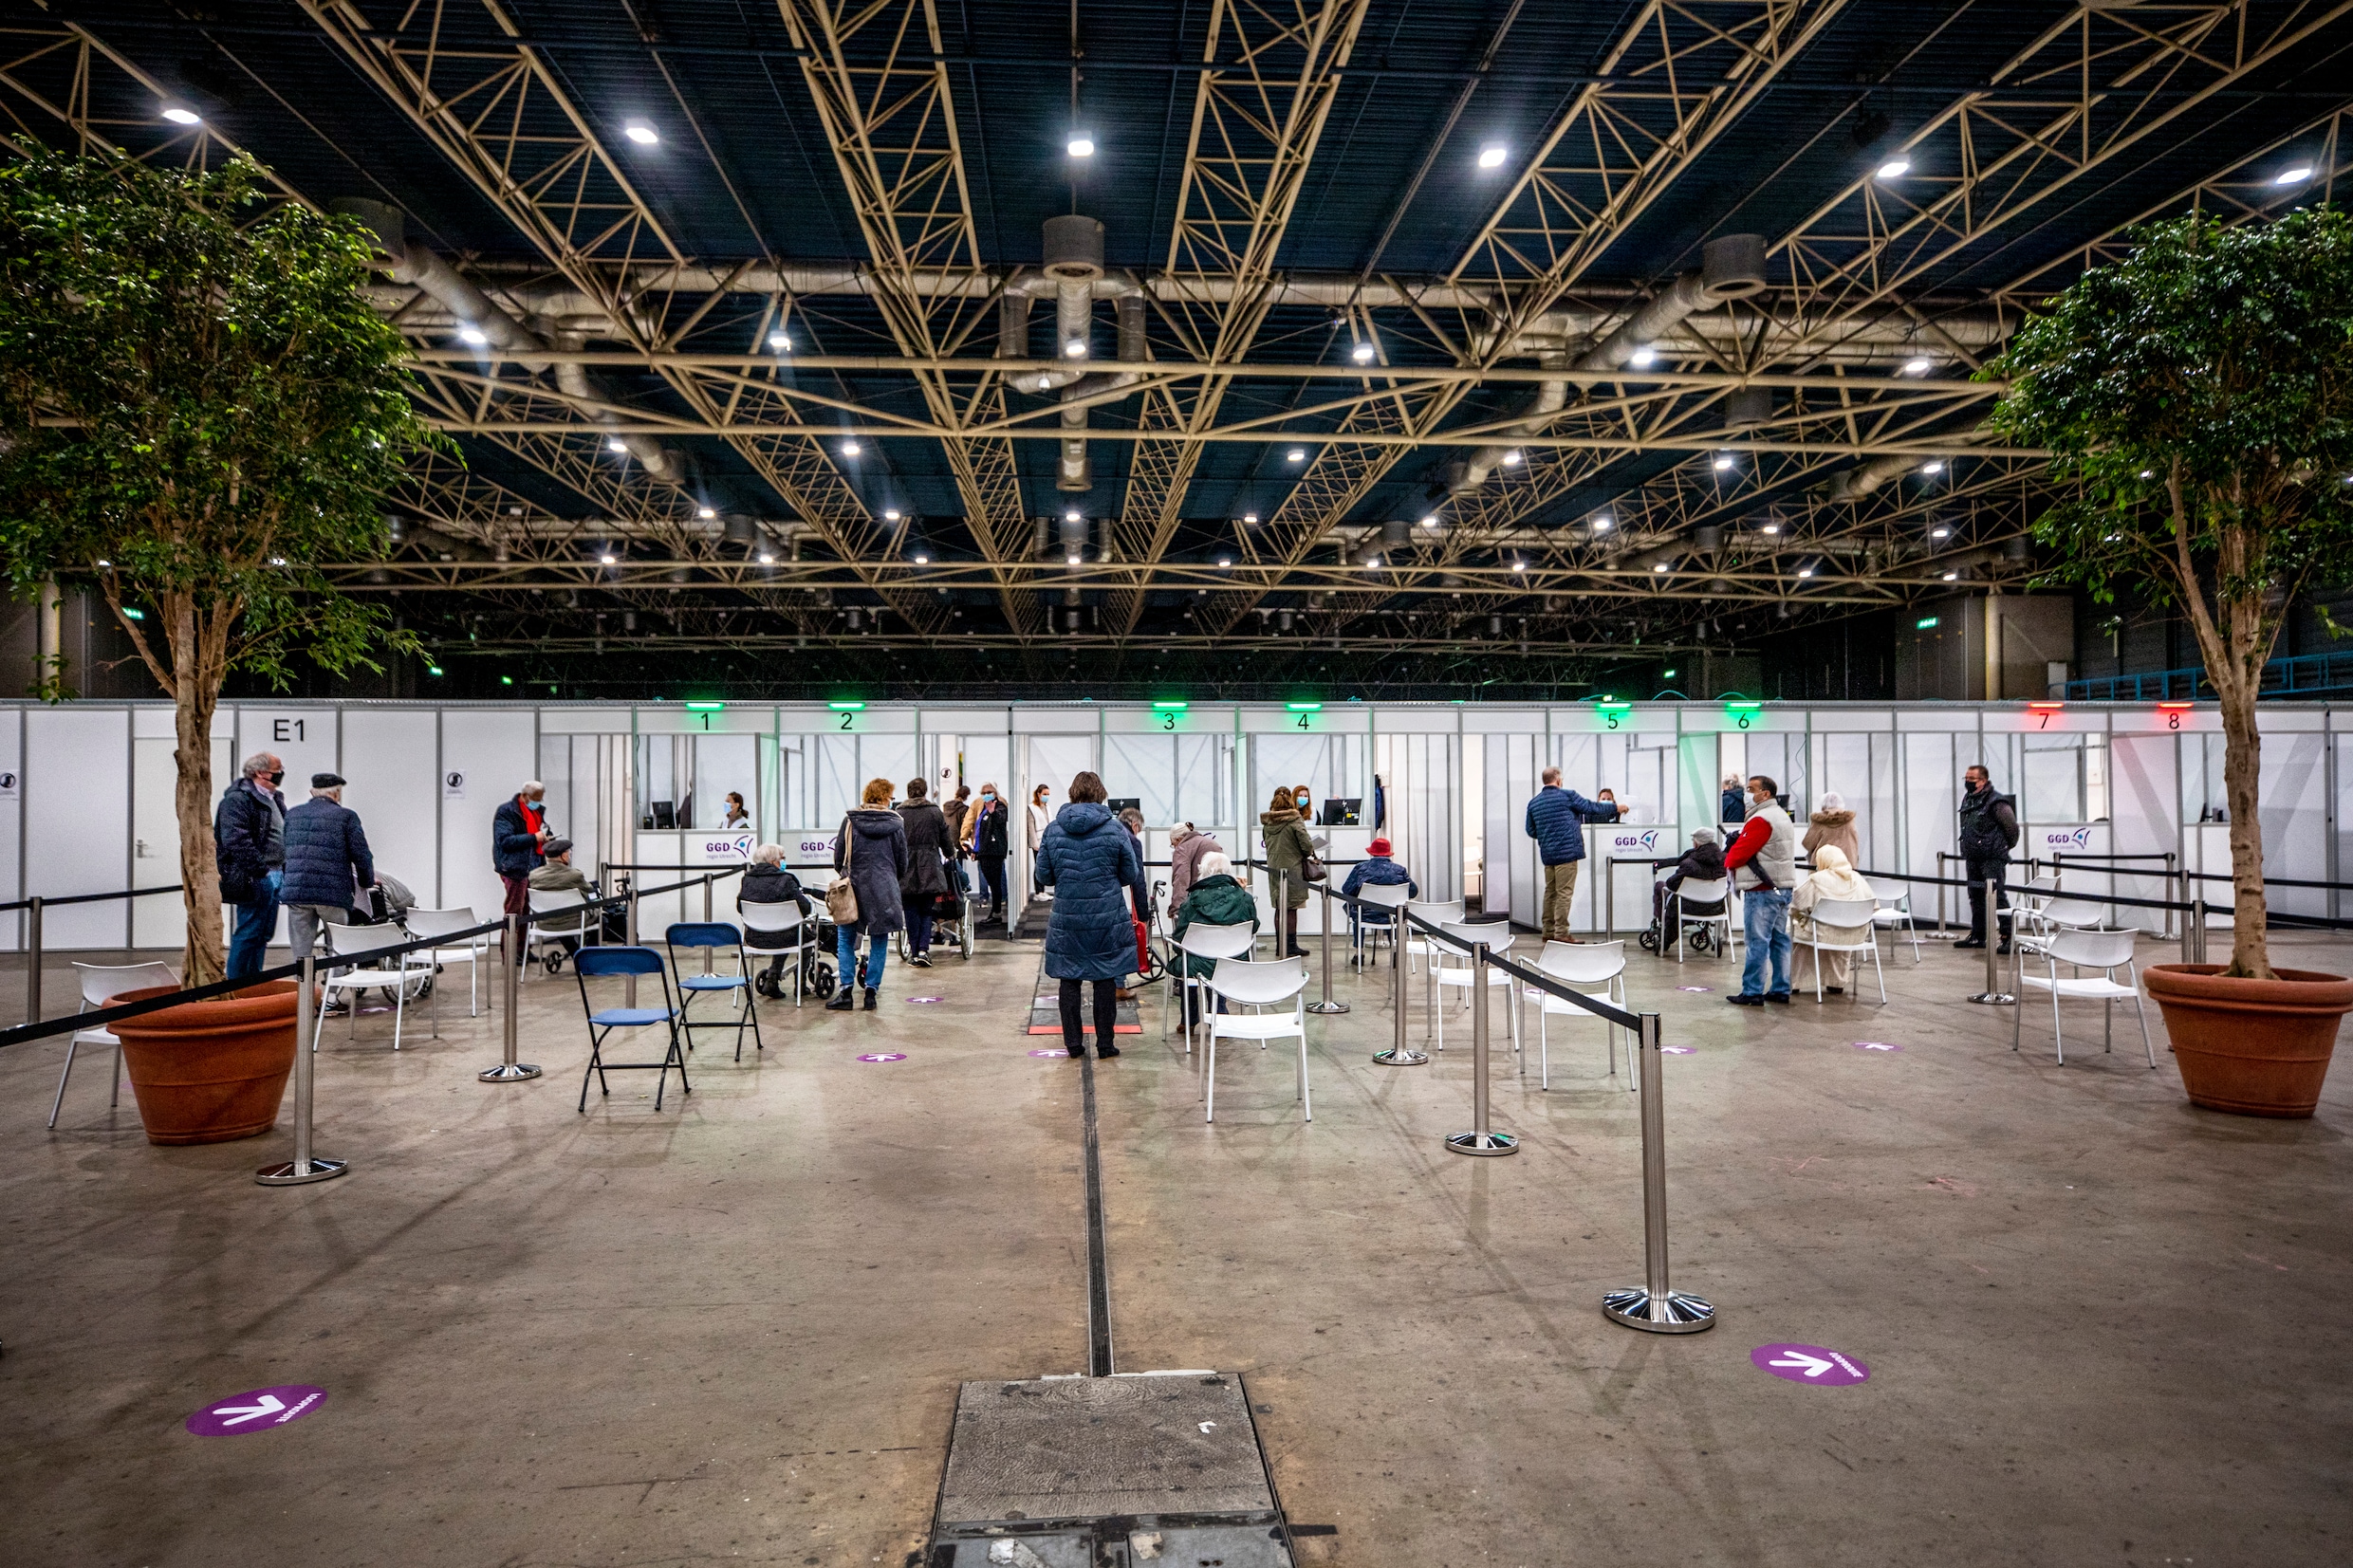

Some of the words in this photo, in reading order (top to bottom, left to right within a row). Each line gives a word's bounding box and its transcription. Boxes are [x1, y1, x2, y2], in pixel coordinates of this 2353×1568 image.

[701, 712, 709, 730] 1
[841, 712, 853, 730] 2
[1163, 712, 1176, 730] 3
[1297, 712, 1309, 730] 4
[1607, 713, 1619, 729] 5
[1738, 712, 1750, 729] 6
[2039, 712, 2049, 729] 7
[2169, 712, 2180, 729] 8
[273, 719, 305, 742] E1
[706, 842, 731, 852] GGD
[801, 841, 824, 852] GGD
[1615, 837, 1638, 846] GGD
[2047, 834, 2069, 843] GGD
